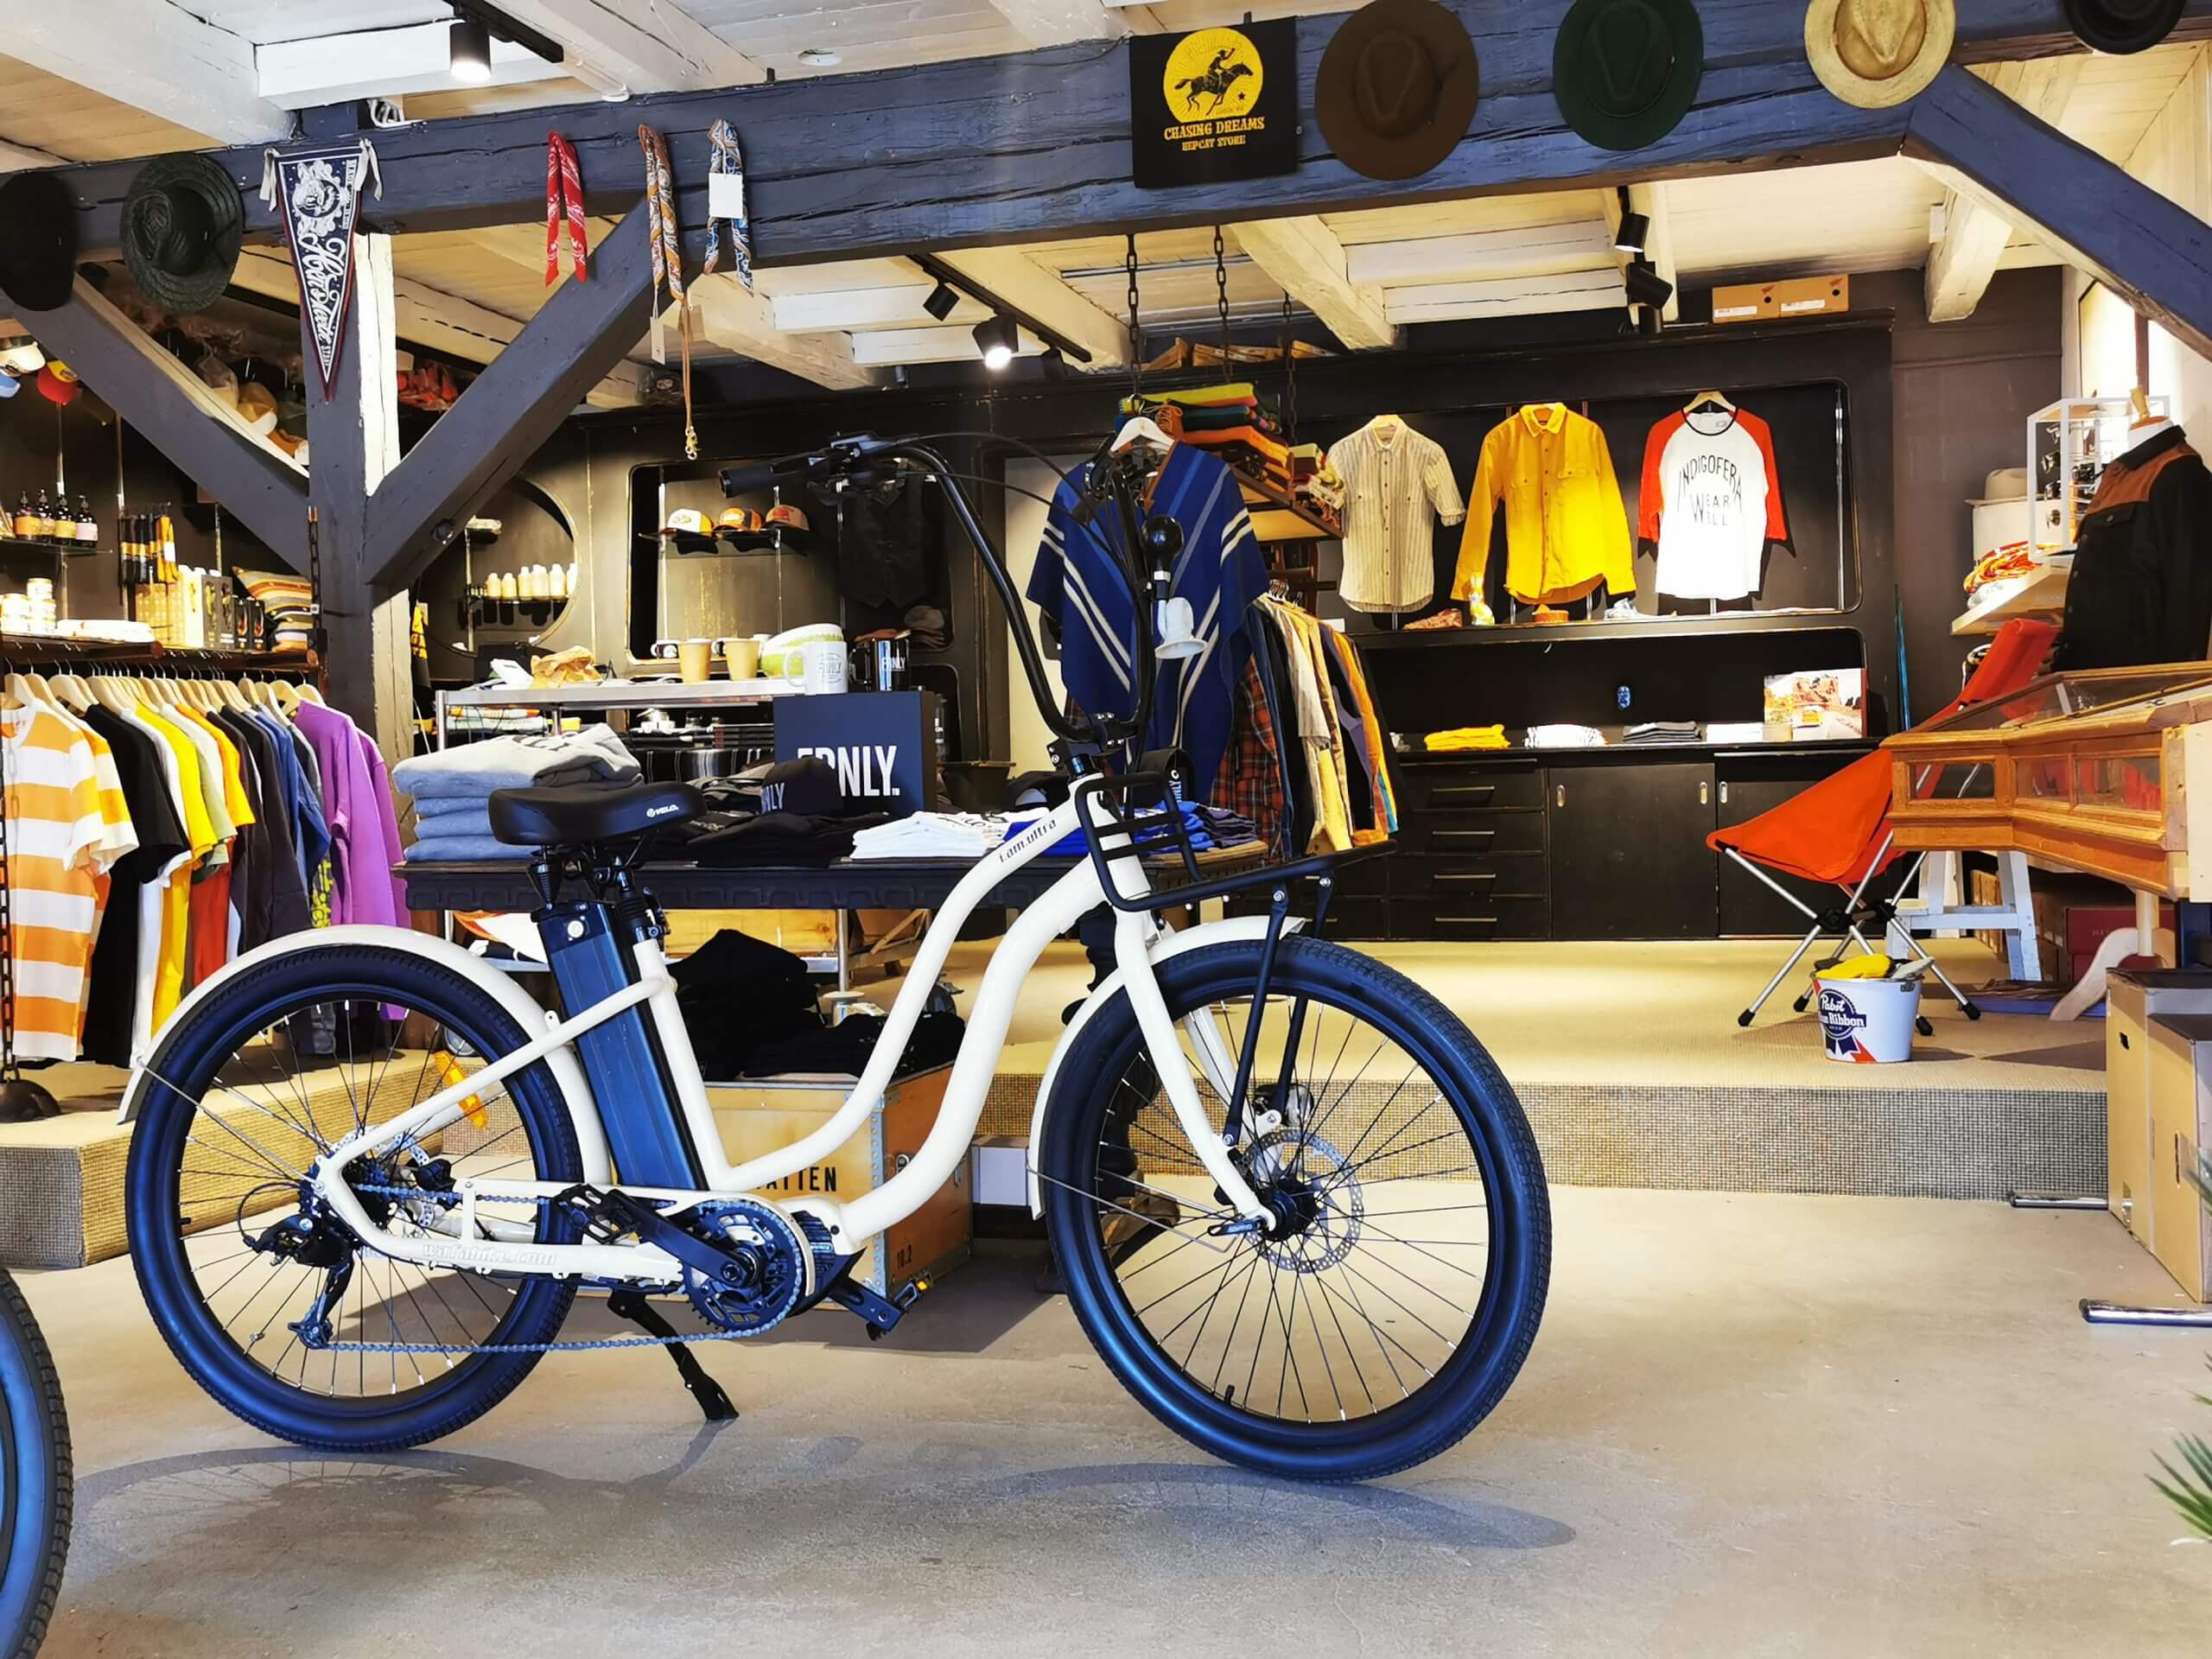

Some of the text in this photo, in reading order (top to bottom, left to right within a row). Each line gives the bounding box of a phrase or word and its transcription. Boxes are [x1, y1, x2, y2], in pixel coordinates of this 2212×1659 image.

[1164, 117, 1265, 140] CHASING DREAMS
[1181, 135, 1246, 151] HEPCAT STORE
[1677, 454, 1743, 514] INDIGOFERA
[1689, 493, 1730, 523] WEAR
[797, 745, 900, 798] NLY.
[1820, 994, 1846, 1013] Pabst
[1828, 1012, 1865, 1027] Ribbon
